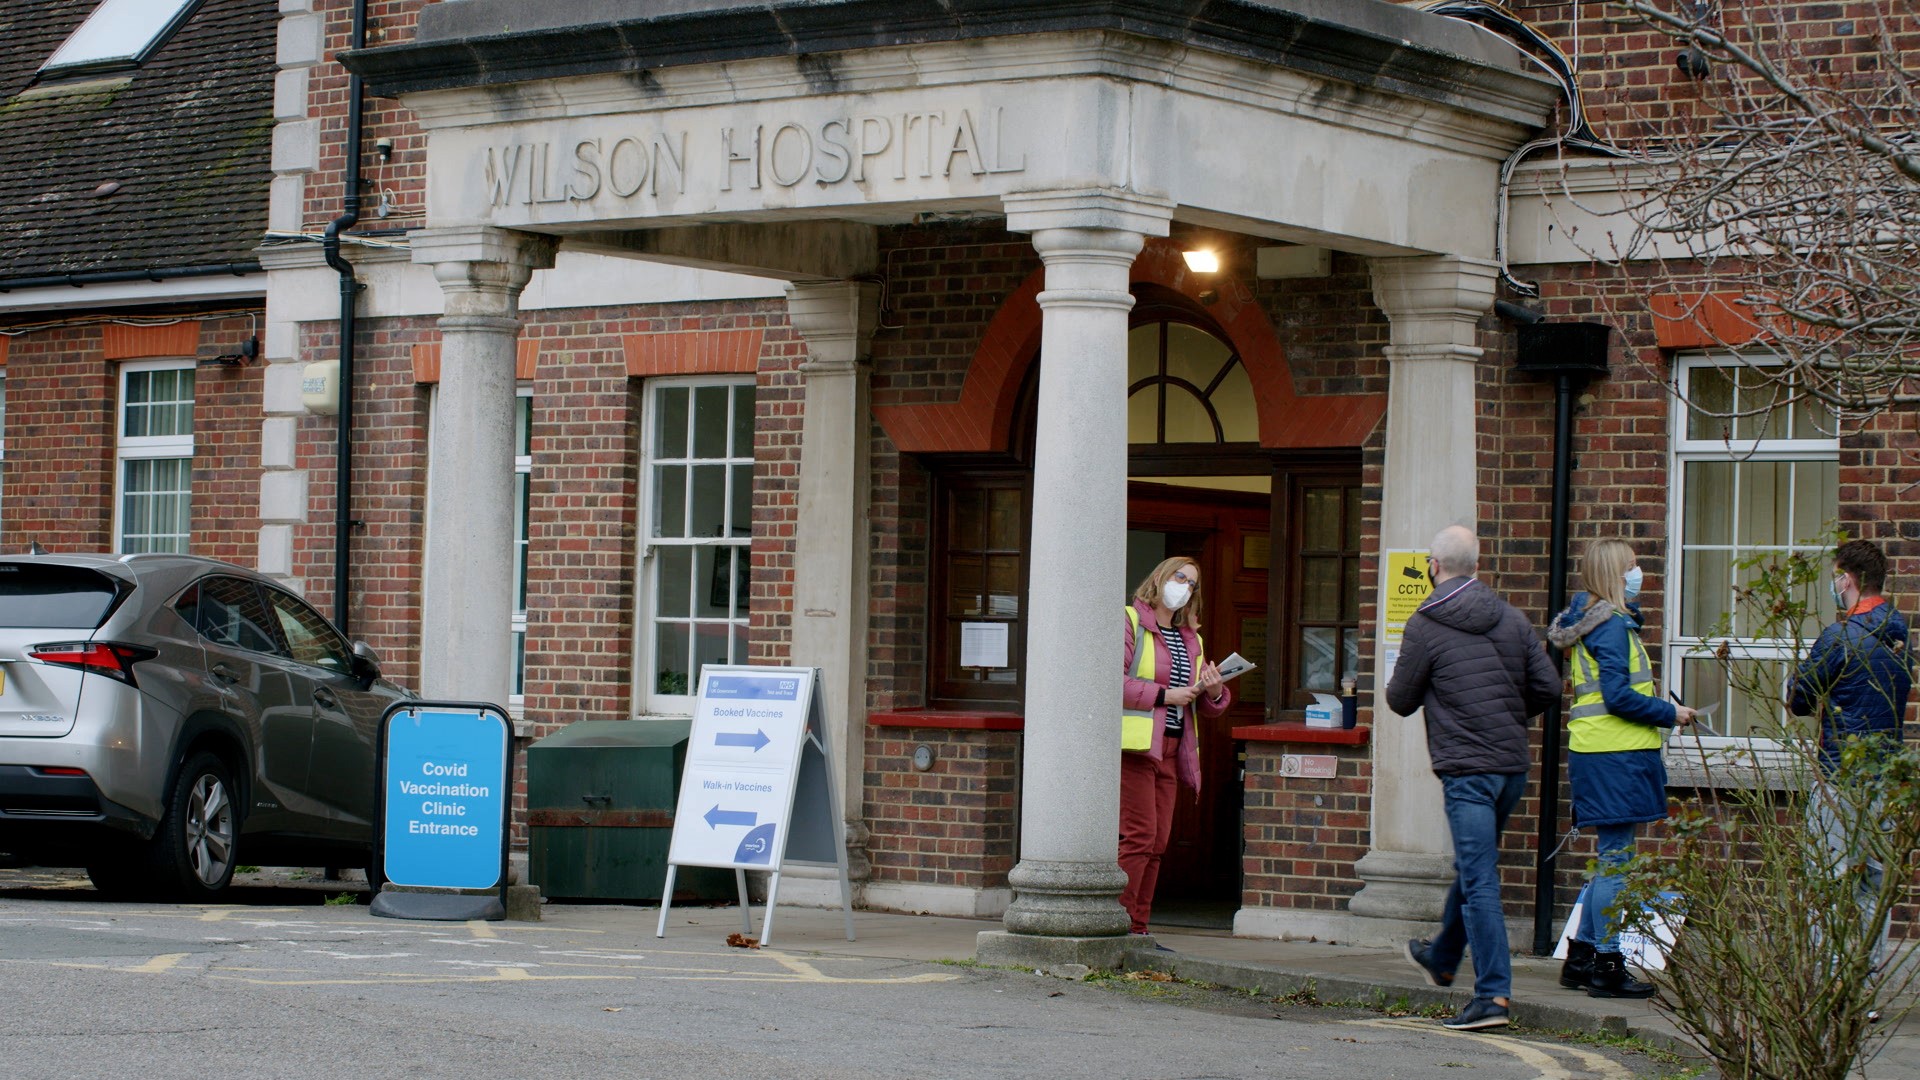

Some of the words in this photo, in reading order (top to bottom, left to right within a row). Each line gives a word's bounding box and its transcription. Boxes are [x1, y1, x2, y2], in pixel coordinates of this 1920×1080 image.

[483, 131, 687, 207] WILSON
[719, 107, 1025, 192] HOSPITAL
[1398, 584, 1427, 595] CCTV
[780, 681, 794, 689] NHS
[713, 707, 744, 717] Booked
[746, 709, 783, 719] Vaccines
[1304, 758, 1315, 766] No
[422, 762, 468, 777] Covid
[1304, 766, 1331, 775] smoking
[400, 781, 489, 797] Vaccination
[703, 780, 732, 791] Walk-in
[734, 782, 772, 793] Vaccines
[422, 801, 466, 816] Clinic
[409, 820, 479, 836] Entrance
